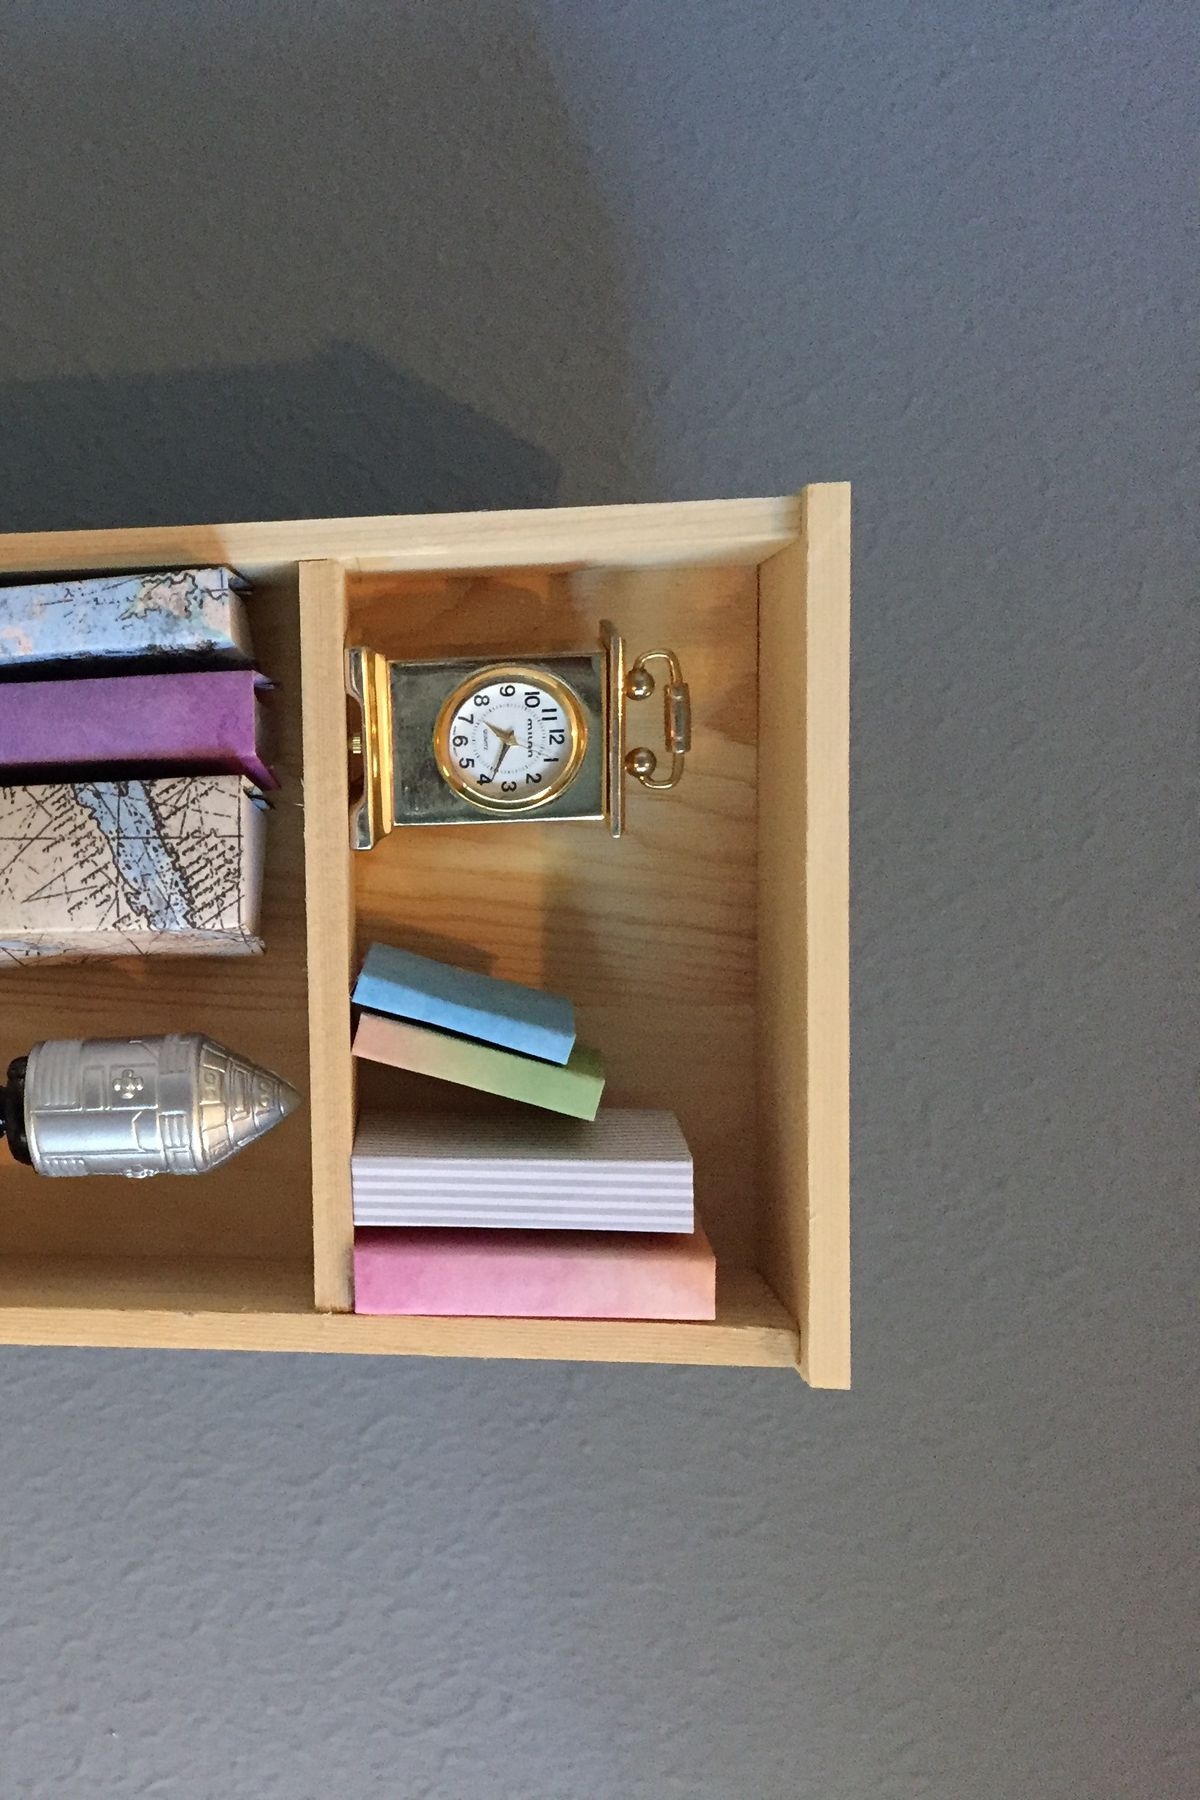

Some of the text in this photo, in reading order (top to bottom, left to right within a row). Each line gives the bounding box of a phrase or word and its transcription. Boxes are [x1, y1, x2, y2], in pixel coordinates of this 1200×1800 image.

[500, 685, 515, 696] 9
[474, 695, 489, 706] 8
[525, 692, 540, 708] 10
[458, 714, 473, 724] 7
[542, 708, 557, 721] 11
[453, 736, 468, 747] 6
[550, 729, 564, 745] 12
[459, 758, 474, 768] 5
[477, 774, 491, 785] 4
[526, 773, 541, 784] 2
[501, 781, 516, 792] 3
